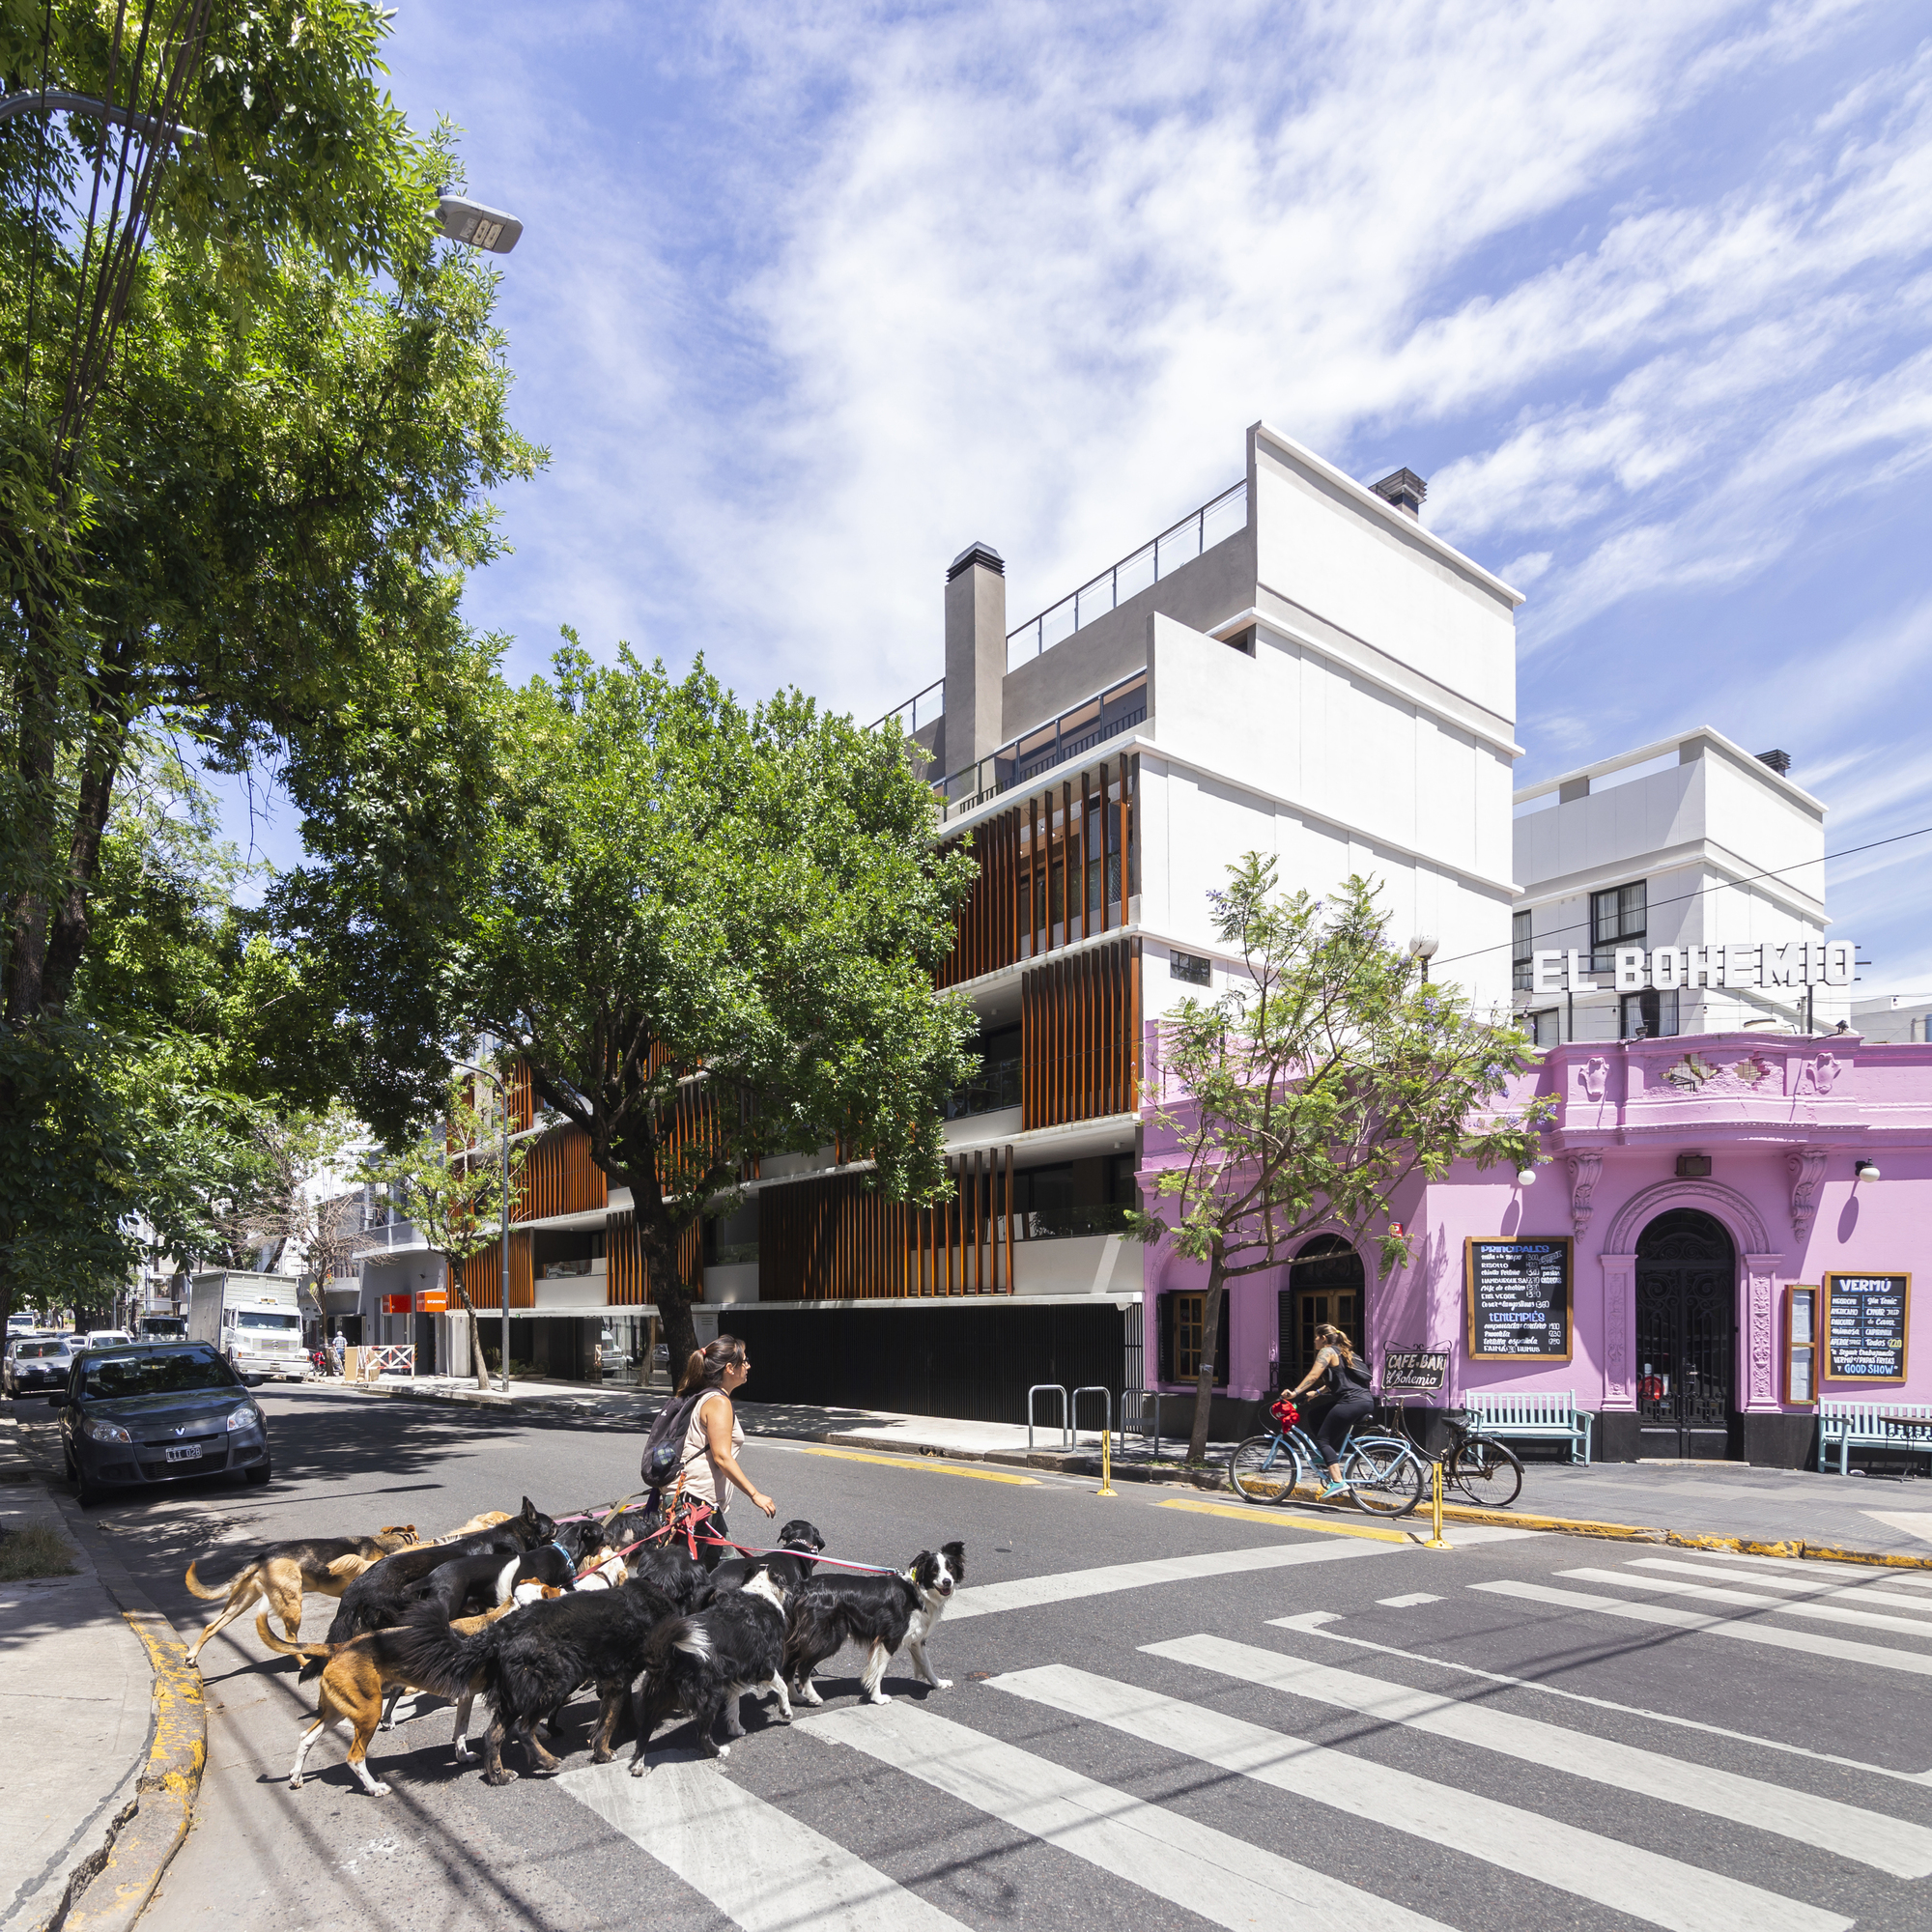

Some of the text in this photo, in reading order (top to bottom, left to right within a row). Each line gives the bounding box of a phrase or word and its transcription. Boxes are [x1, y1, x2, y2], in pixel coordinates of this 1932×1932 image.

[1532, 940, 1857, 994] EL BOHEMIO
[1839, 1277, 1892, 1293] VERMÚ
[1844, 1363, 1867, 1375] GOOD
[1391, 1370, 1437, 1386] Bohemio
[186, 1447, 201, 1458] 028
